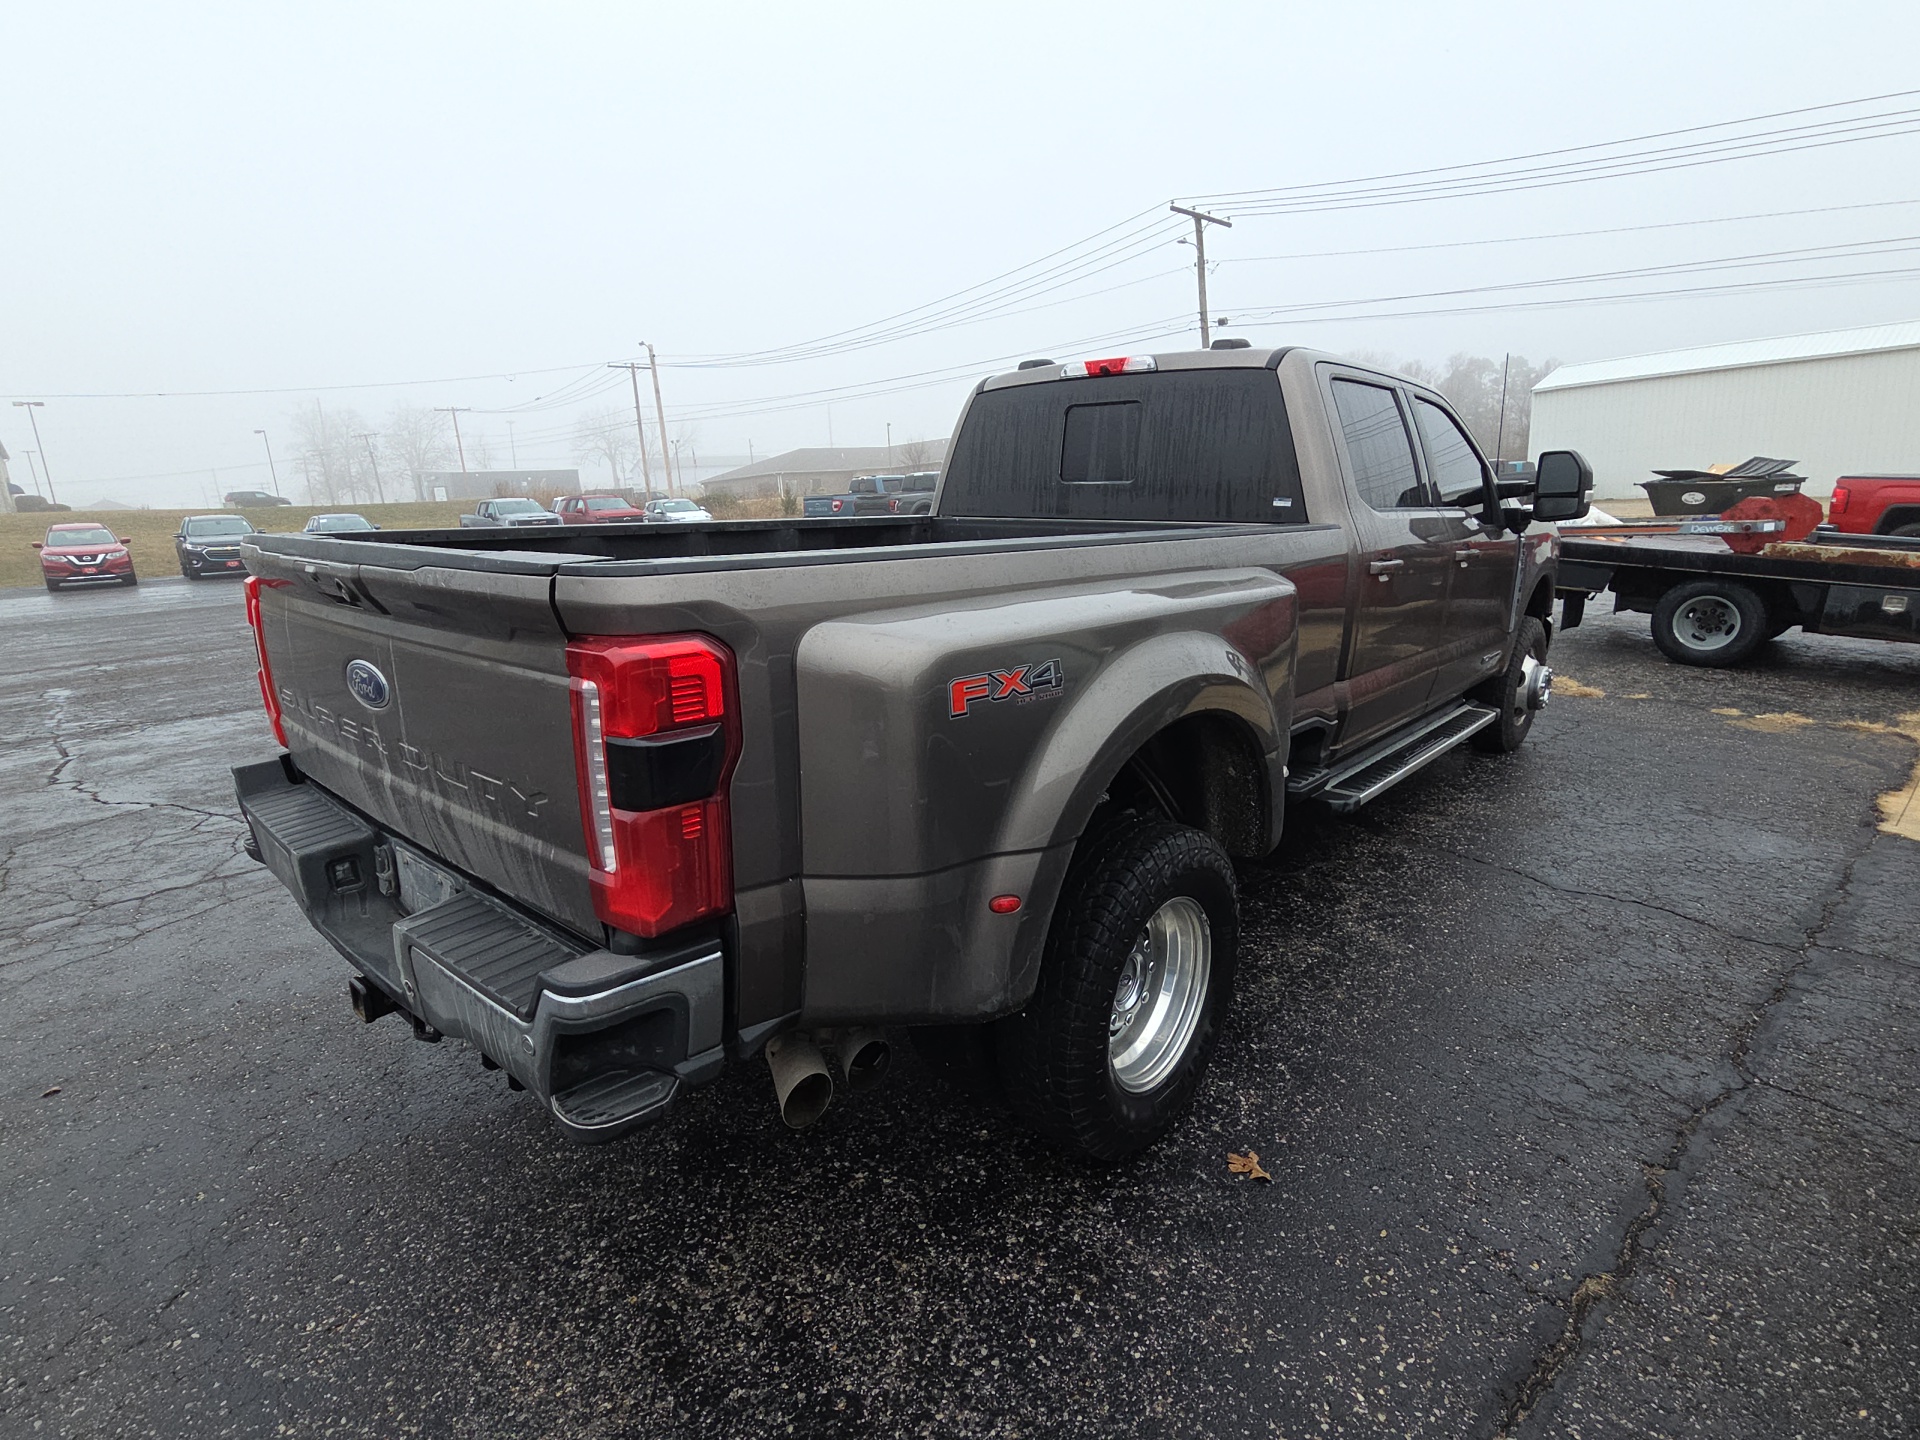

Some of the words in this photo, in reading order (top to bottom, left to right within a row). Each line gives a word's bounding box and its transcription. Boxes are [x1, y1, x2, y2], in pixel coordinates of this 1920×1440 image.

[352, 669, 376, 698] Ford
[947, 658, 1064, 720] FX4
[280, 687, 388, 755] SUPER
[399, 742, 549, 818] DUTY
